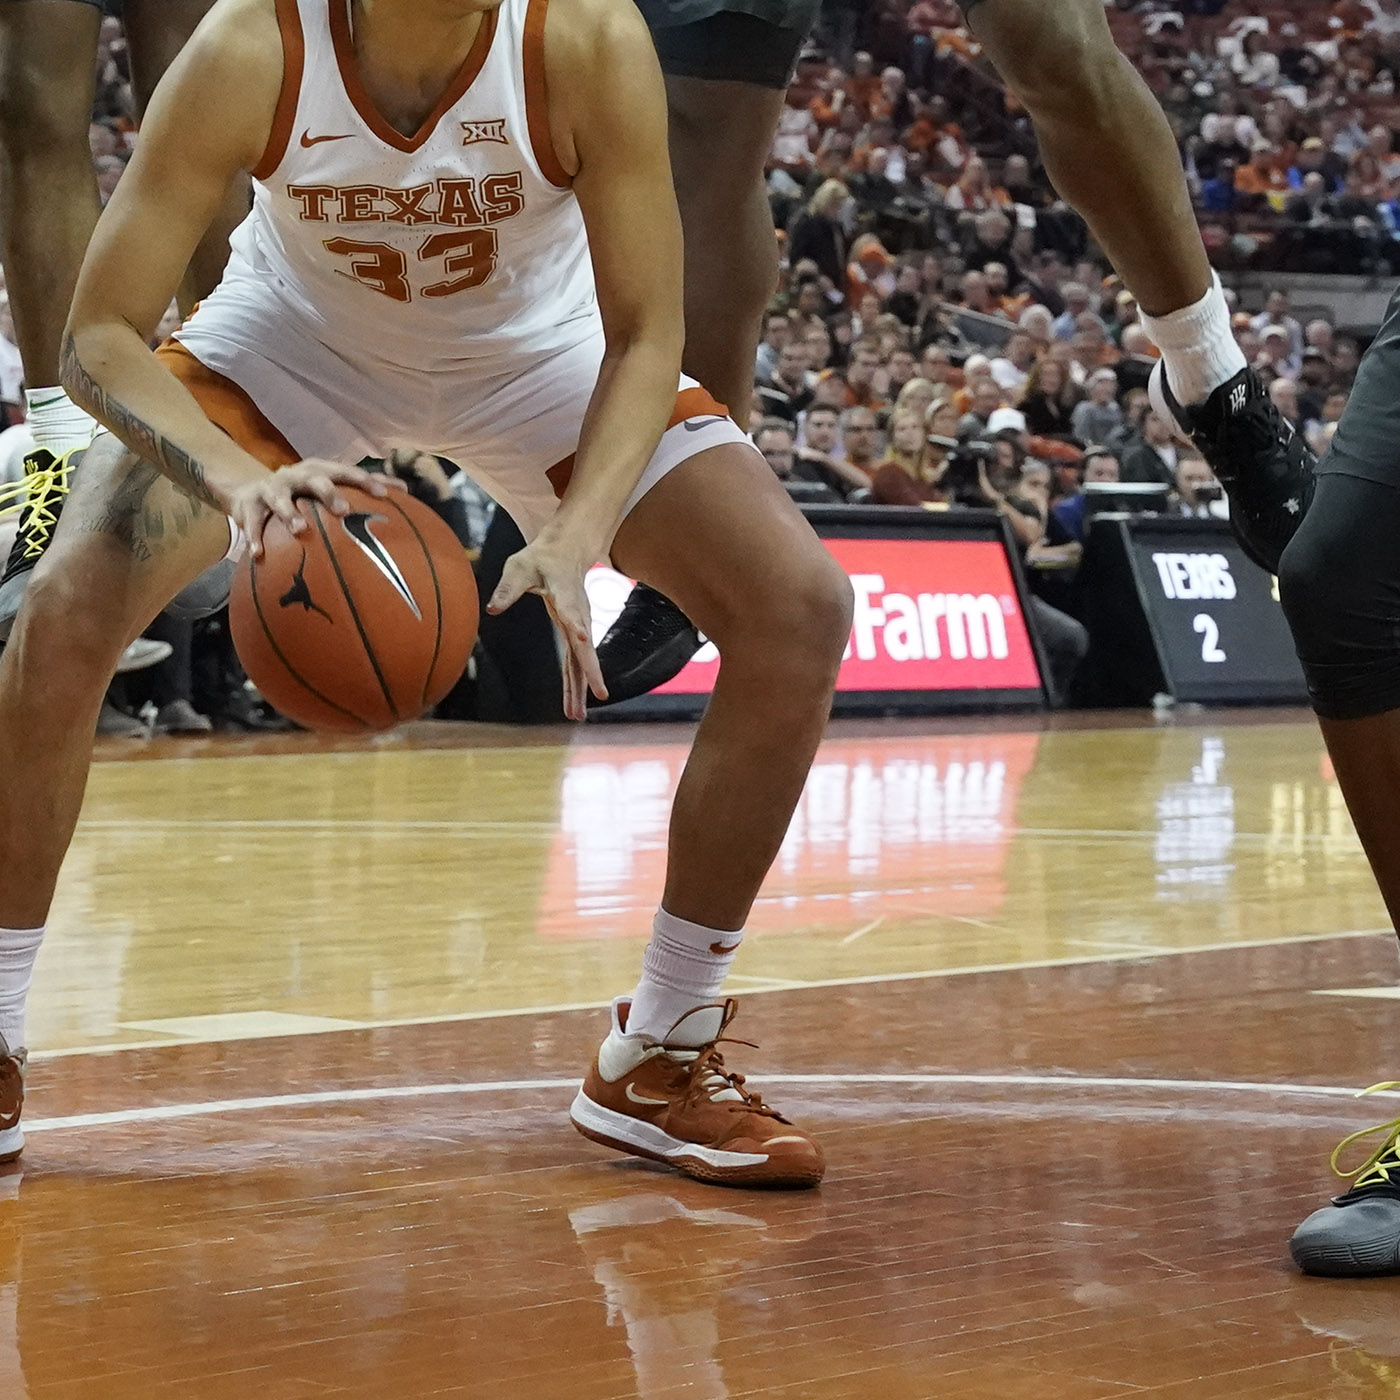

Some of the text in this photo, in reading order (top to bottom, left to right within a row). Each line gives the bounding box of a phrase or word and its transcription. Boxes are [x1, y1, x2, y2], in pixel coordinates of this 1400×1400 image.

[287, 171, 525, 227] TEXAS
[322, 227, 499, 303] 33
[1151, 552, 1237, 600] TEXAS
[848, 573, 1010, 662] Farm
[1193, 612, 1227, 663] 2
